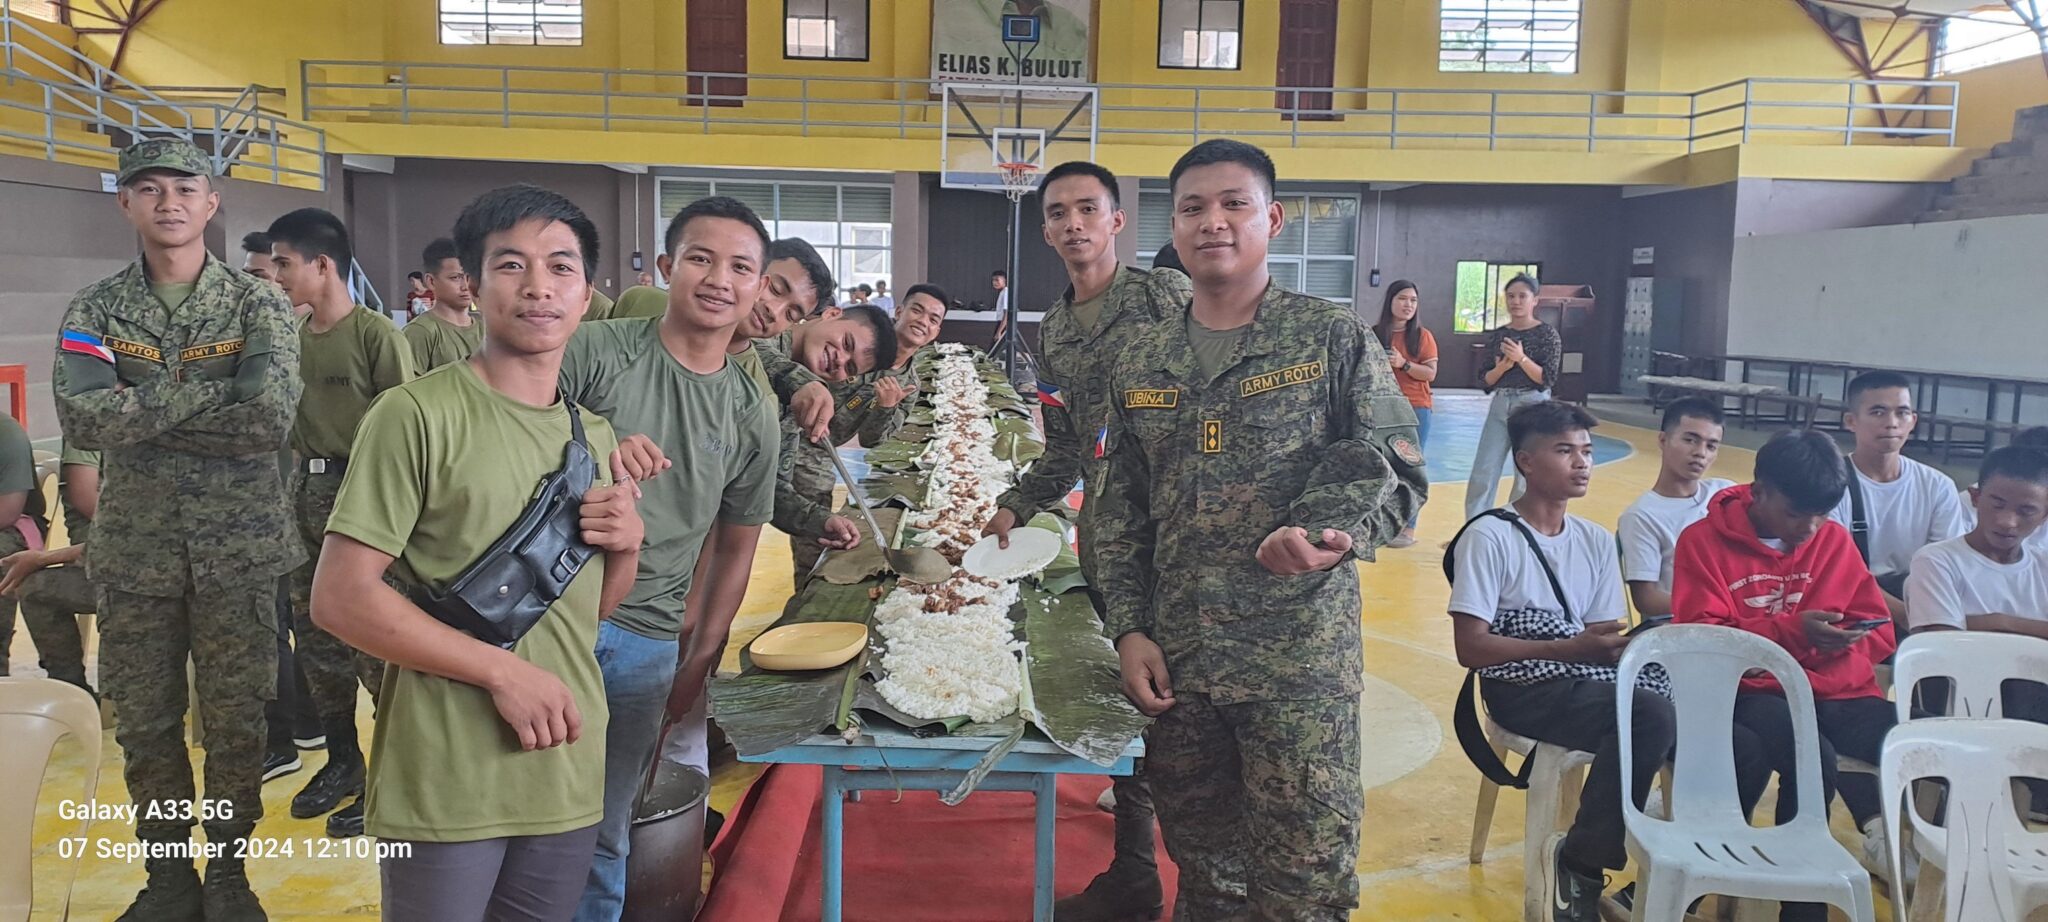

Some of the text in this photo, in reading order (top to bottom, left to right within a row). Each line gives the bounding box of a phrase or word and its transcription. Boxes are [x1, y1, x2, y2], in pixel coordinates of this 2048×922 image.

[938, 53, 1082, 78] ELIAS K. BULUT
[113, 340, 161, 359] SANTOS
[183, 341, 243, 359] ARMY ROTC
[1245, 364, 1320, 394] ARMY ROTC
[1130, 391, 1164, 404] UBIÑA
